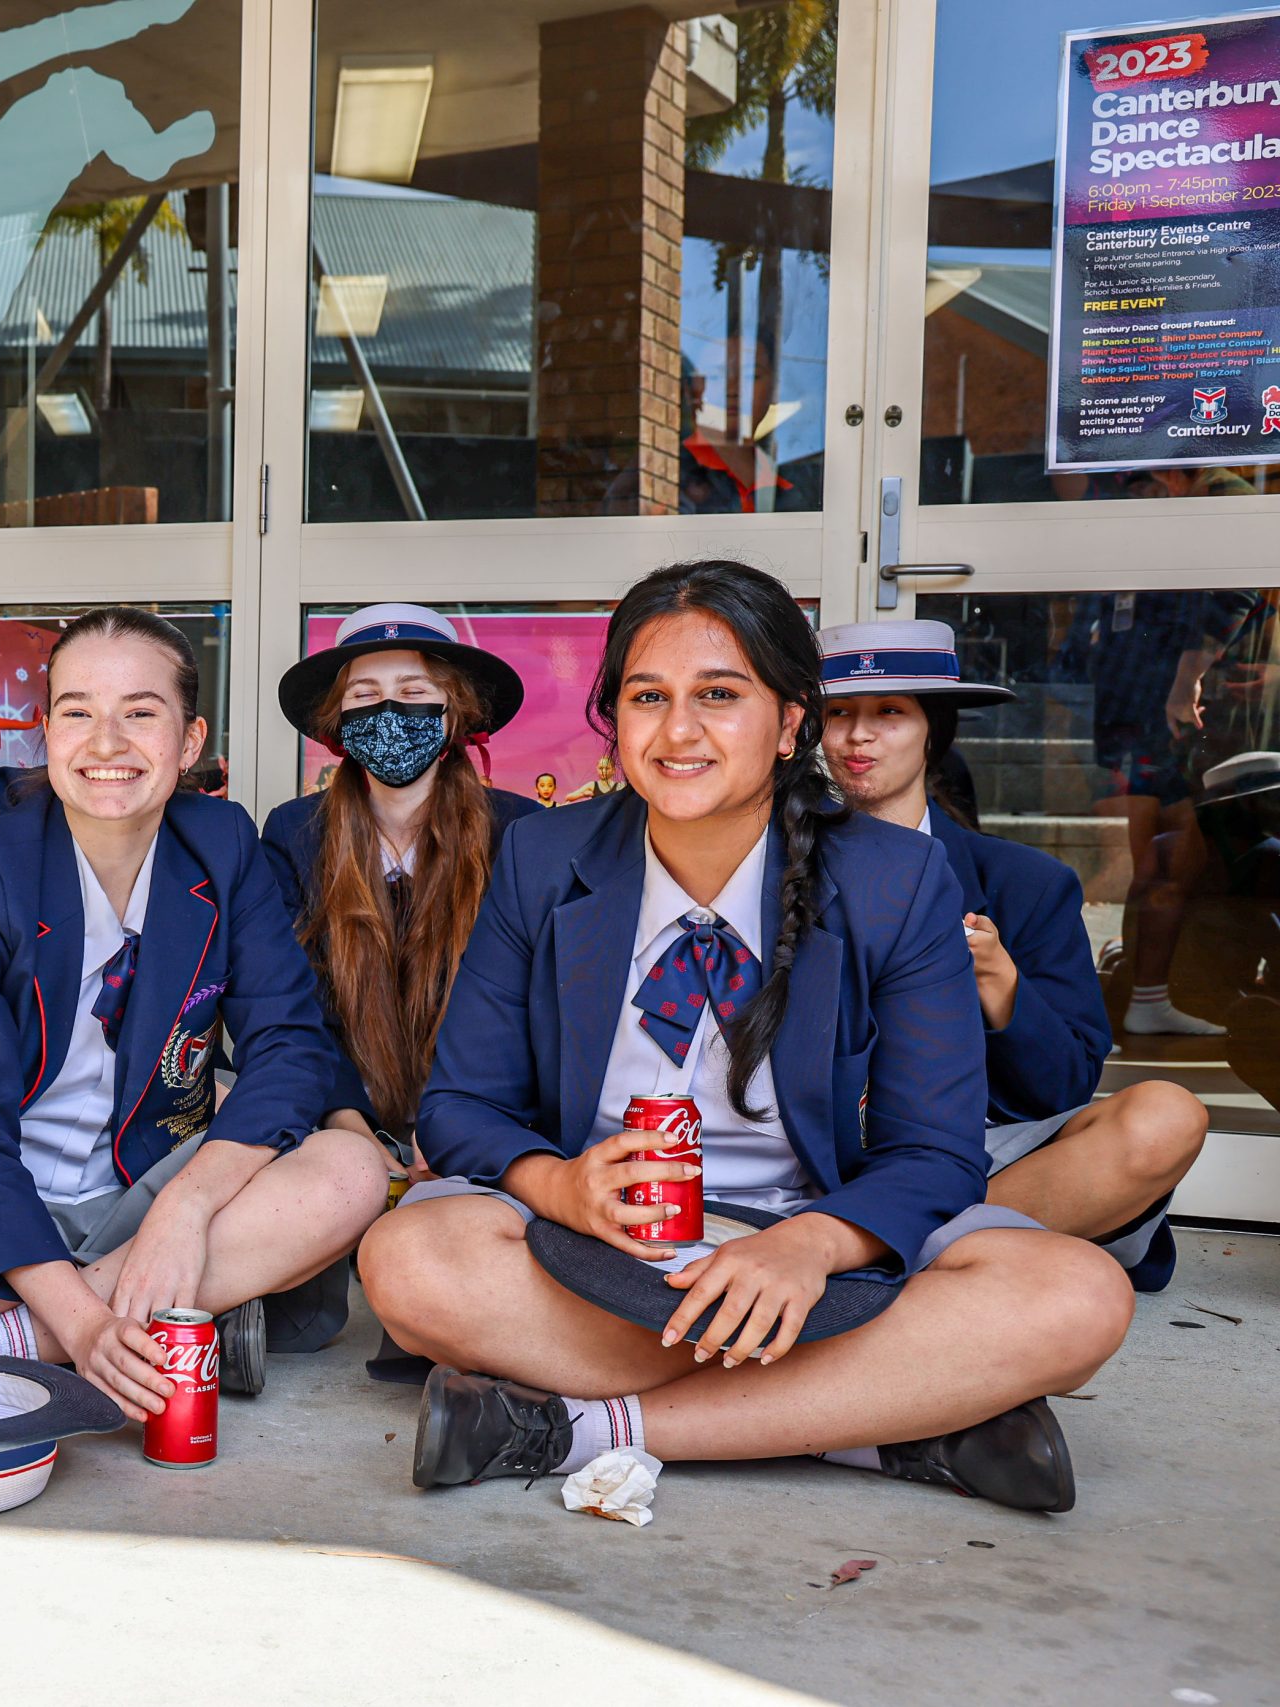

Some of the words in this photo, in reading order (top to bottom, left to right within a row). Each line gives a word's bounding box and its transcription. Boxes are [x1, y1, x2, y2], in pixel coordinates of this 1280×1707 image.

[1095, 40, 1192, 81] 2023
[1092, 80, 1280, 118] Canterbury
[1092, 117, 1199, 146] Dance
[1088, 183, 1151, 198] 6:00pm
[1167, 176, 1228, 191] 7:45pm
[1088, 198, 1137, 212] Friday
[1140, 196, 1146, 208] 1
[1150, 190, 1239, 208] September
[1242, 184, 1280, 200] 2023
[1087, 228, 1157, 241] Canterbury
[1161, 223, 1203, 235] Events
[1207, 220, 1251, 232] Centre
[1086, 238, 1157, 251] Canterbury
[1161, 234, 1210, 245] College
[1110, 253, 1133, 262] Junior
[1134, 251, 1160, 260] School
[1162, 249, 1195, 257] Entrance
[1210, 247, 1228, 255] High
[1094, 263, 1117, 271] Plenty
[1128, 260, 1151, 268] onsite
[1152, 259, 1182, 268] parking.
[1175, 273, 1216, 282] Secondary
[1084, 289, 1109, 297] School
[1111, 287, 1144, 295] Students
[1152, 284, 1183, 292] Families
[1192, 281, 1222, 289] Friends.
[1083, 300, 1118, 312] FREE
[1120, 297, 1167, 310] EVENT
[1082, 325, 1131, 335] Canterbury
[1160, 321, 1192, 331] Groups
[1194, 318, 1236, 328] Featured:
[1102, 338, 1130, 346] Dance
[1219, 330, 1263, 339] Company
[1140, 345, 1163, 353] Class
[1169, 343, 1196, 352] Ignite
[1198, 341, 1226, 349] Dance
[1228, 339, 1273, 348] Company
[1138, 353, 1188, 362] Canterbury
[1220, 348, 1265, 358] Company
[1098, 366, 1117, 374] Hop
[1118, 364, 1147, 373] Squad
[1153, 363, 1177, 371] Little
[1178, 360, 1220, 369] Groovers
[1227, 359, 1249, 367] Prep
[1081, 375, 1131, 384] Canterbury
[1162, 371, 1194, 380] Troupe
[1200, 369, 1241, 378] BoyZone
[1080, 398, 1092, 406] So
[1121, 396, 1139, 404] and
[1140, 395, 1166, 404] enjoy
[1087, 407, 1110, 415] wide
[1111, 405, 1143, 414] variety
[1144, 404, 1155, 412] of
[1079, 417, 1115, 426] exciting
[1079, 427, 1105, 436] styles
[1107, 426, 1127, 434] with
[1167, 423, 1251, 438] Canterbury
[185, 1383, 216, 1394] CLASSIC
